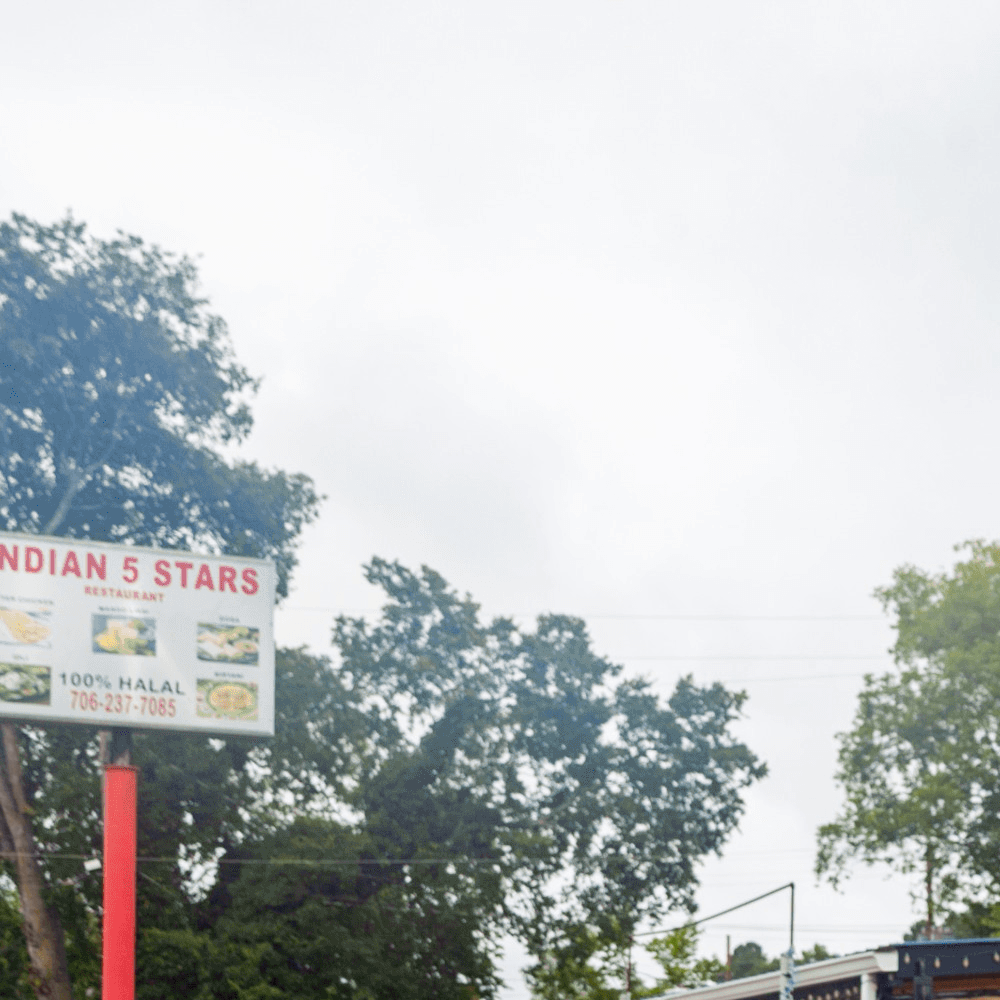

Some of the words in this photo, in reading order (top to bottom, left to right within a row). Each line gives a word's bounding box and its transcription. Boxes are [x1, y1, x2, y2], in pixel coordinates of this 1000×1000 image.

[122, 556, 139, 584] 5
[153, 559, 260, 596] STARS
[84, 585, 165, 602] RESTAURANT
[60, 672, 112, 690] 100%
[118, 676, 186, 696] HALAL
[70, 689, 177, 718] 706-237-7085
